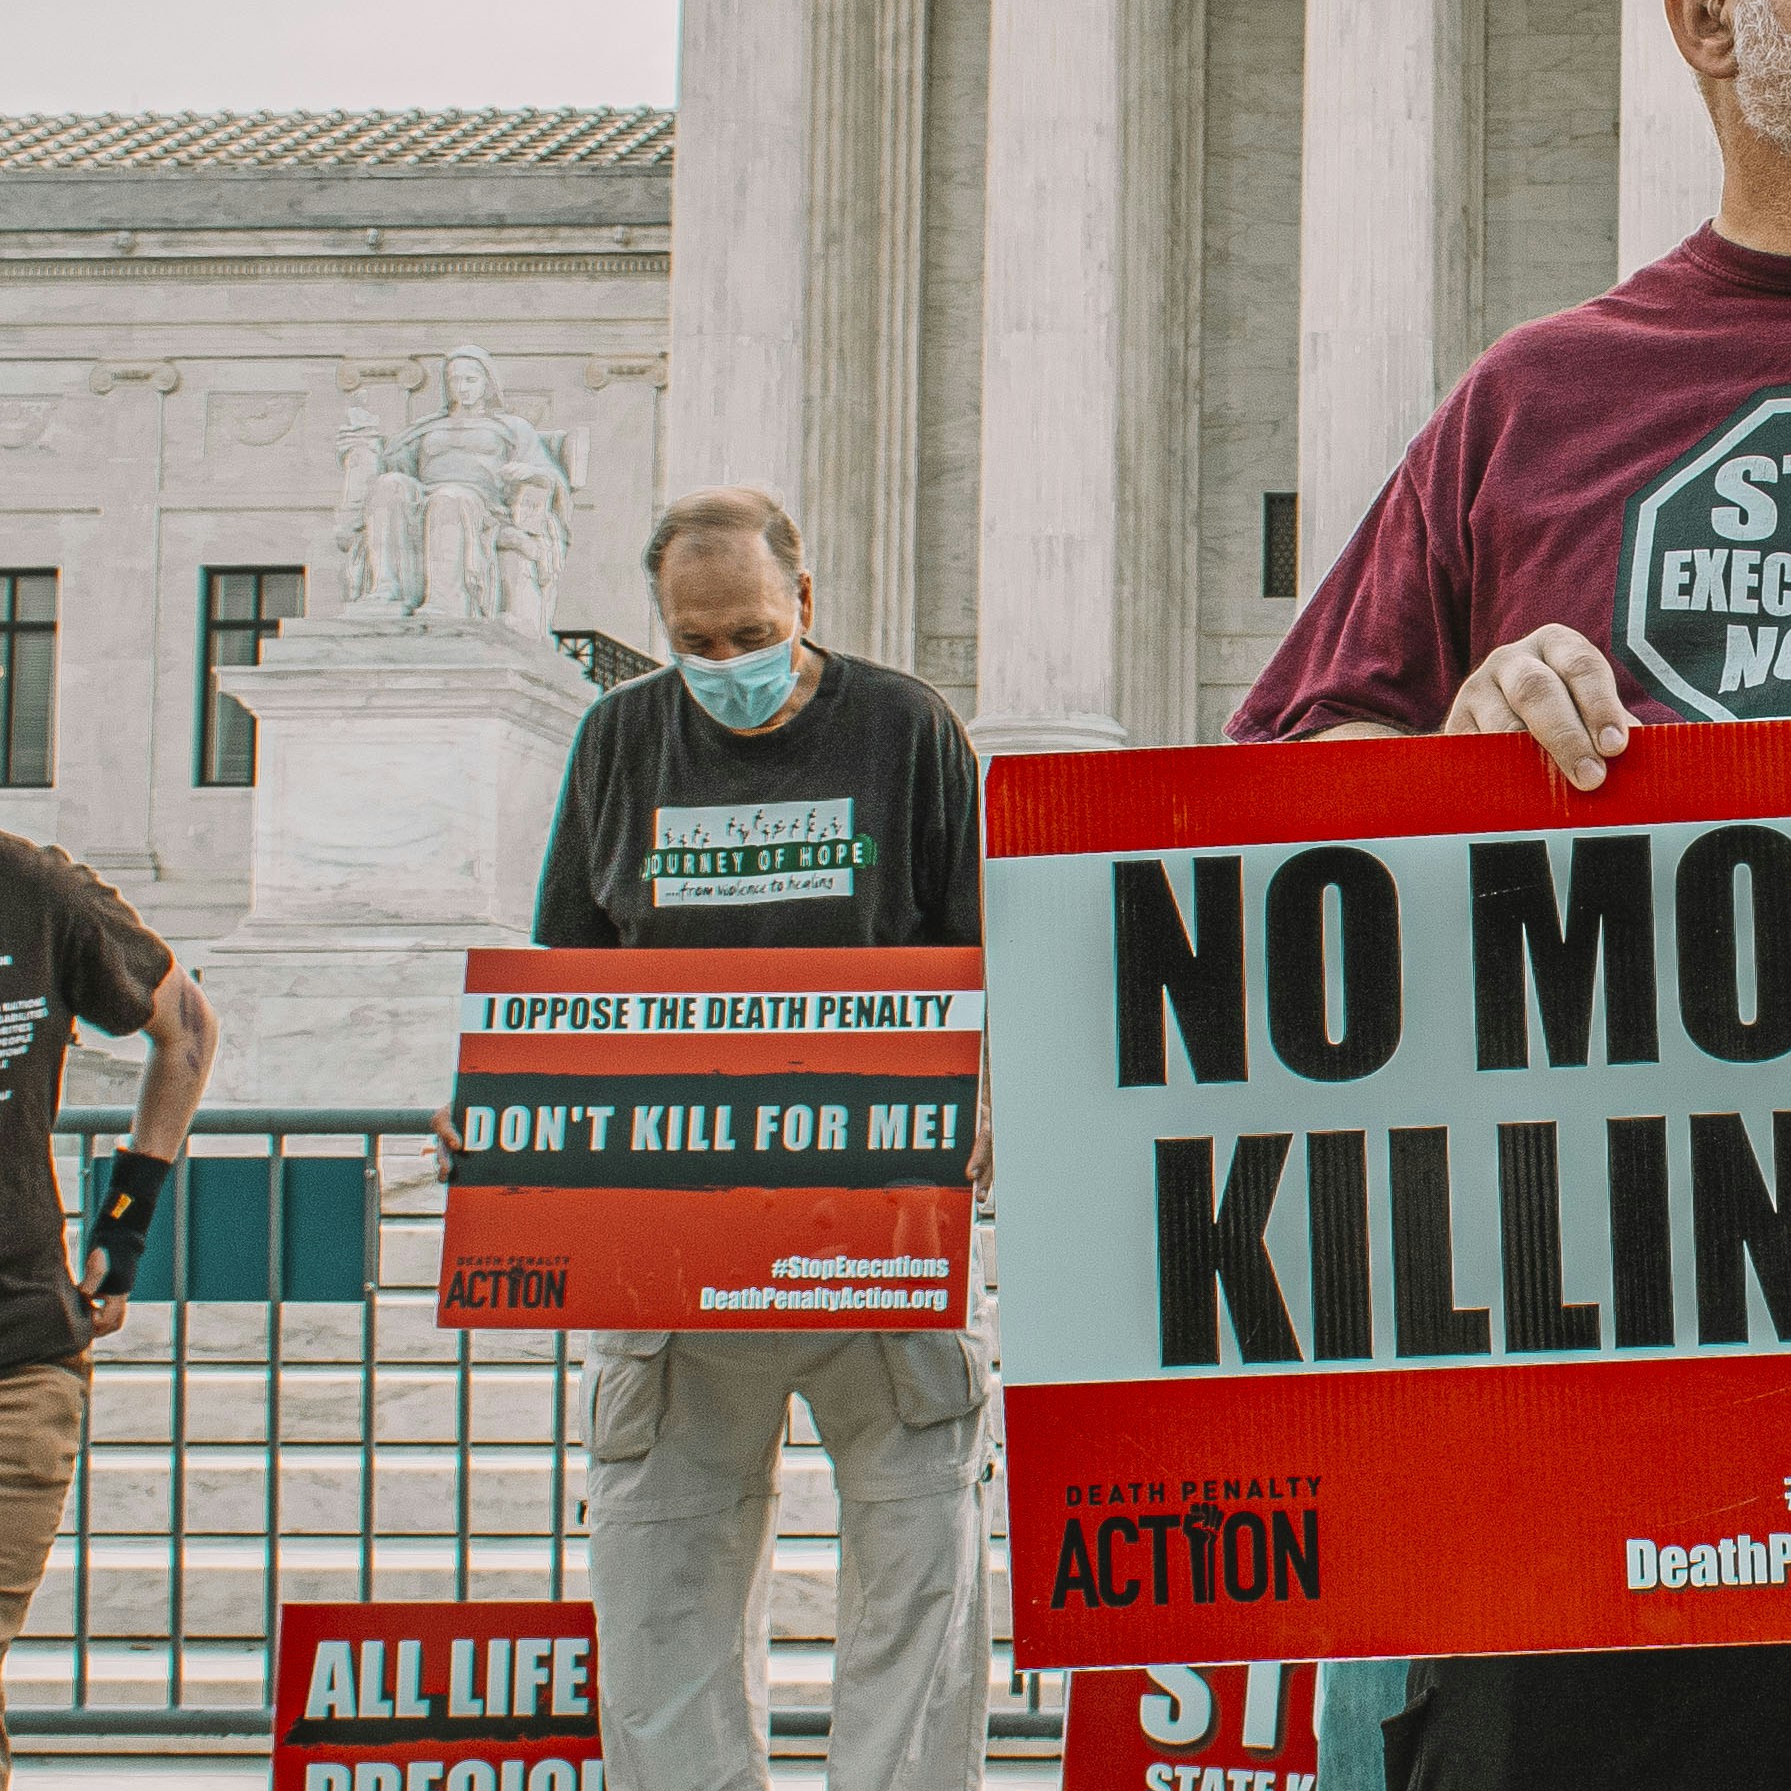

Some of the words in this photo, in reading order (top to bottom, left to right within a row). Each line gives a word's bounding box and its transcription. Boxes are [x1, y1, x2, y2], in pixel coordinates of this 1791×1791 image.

[642, 852, 743, 880] JOURNEY
[758, 848, 785, 871] OF
[800, 842, 864, 866] HOPE
[770, 878, 784, 892] to
[1112, 846, 1402, 1087] NO
[485, 997, 498, 1029] I
[506, 997, 629, 1030] OPPOSE
[639, 997, 697, 1030] THE
[706, 996, 808, 1030] DEATH
[817, 995, 954, 1028] PENALTY
[464, 1105, 615, 1152] DON'T
[632, 1105, 736, 1151] KILL
[756, 1105, 847, 1151] FOR
[868, 1104, 959, 1150] ME!
[771, 1255, 949, 1280] #StopExecutions
[445, 1268, 566, 1308] ACTION
[700, 1286, 948, 1312] DeathPenaltyAction.org
[1066, 1483, 1165, 1506] DEATH
[1181, 1476, 1321, 1502] PENALTY
[1050, 1507, 1320, 1609] ACTION
[304, 1639, 430, 1719] ALL
[448, 1638, 590, 1717] LIFE
